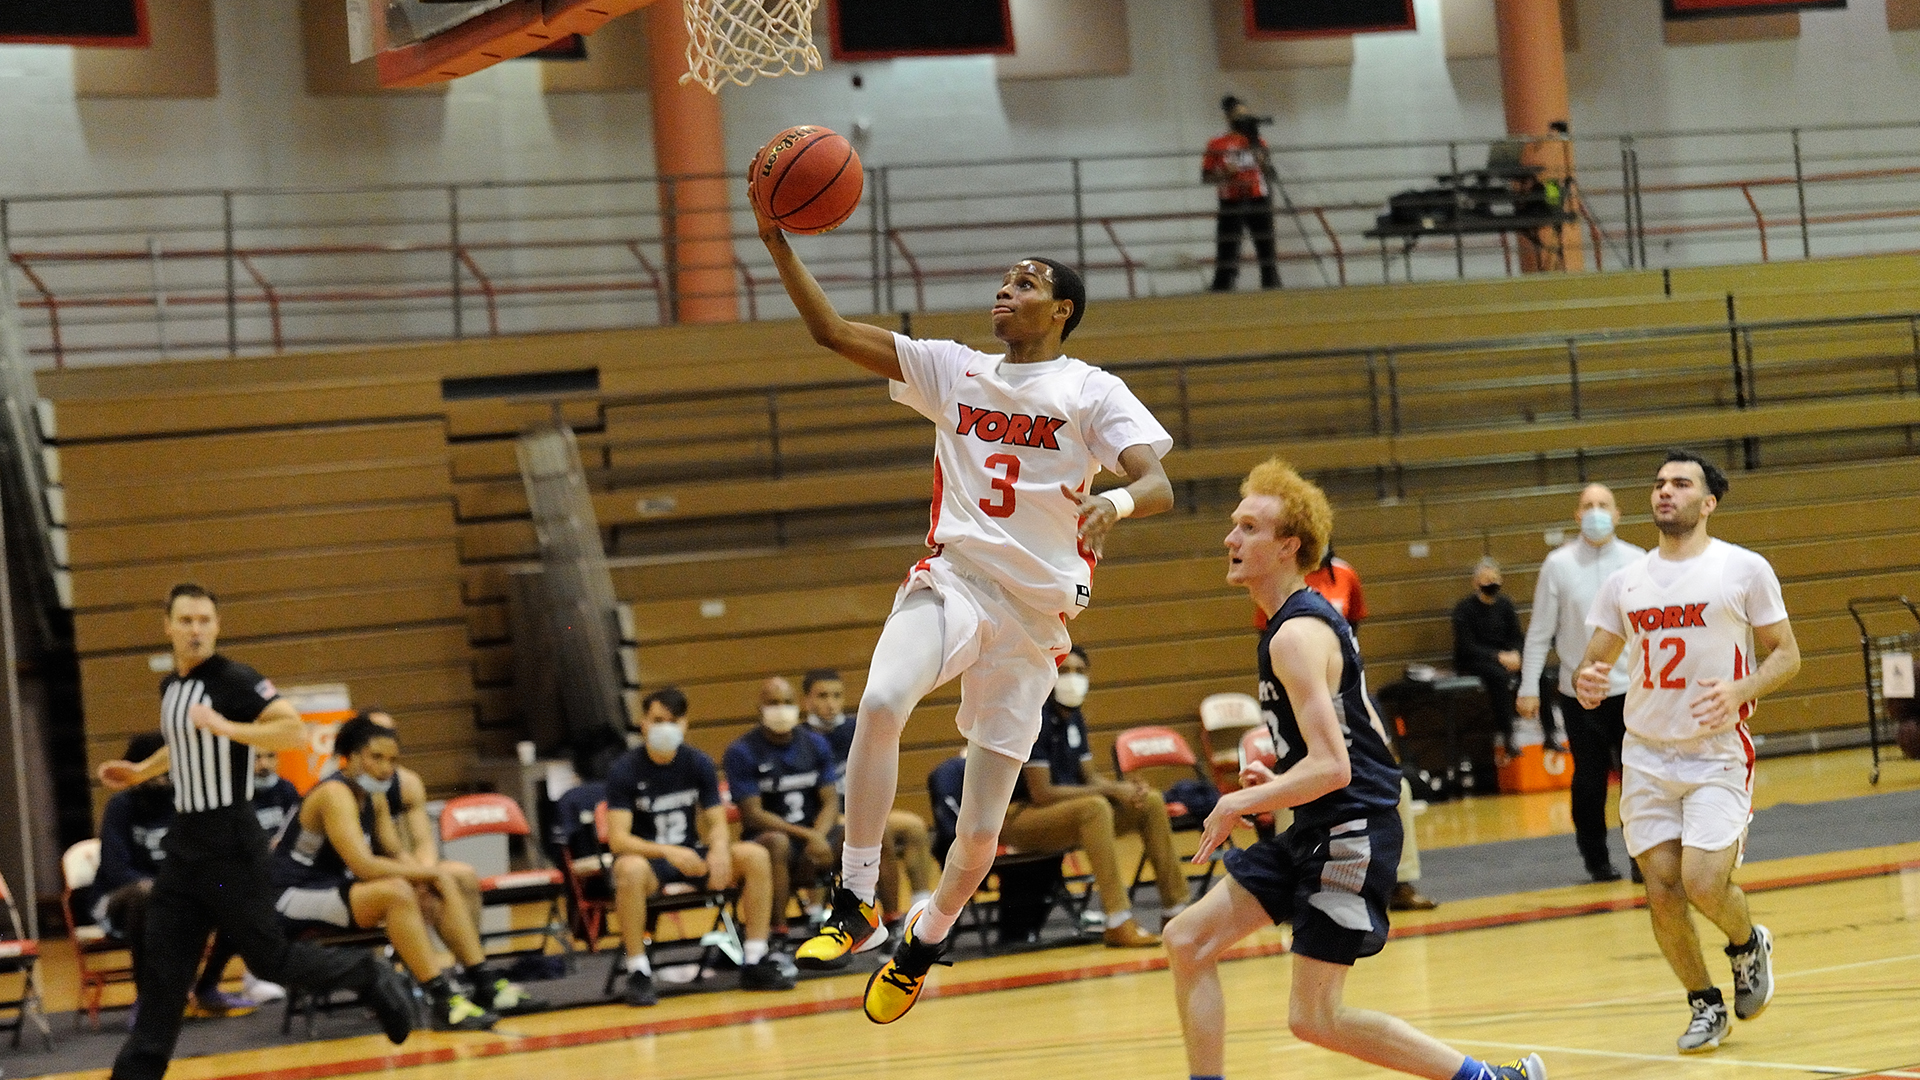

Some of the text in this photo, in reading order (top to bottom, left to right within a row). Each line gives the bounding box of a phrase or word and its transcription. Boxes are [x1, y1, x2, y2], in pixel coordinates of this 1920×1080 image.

[956, 402, 1067, 451] YORK
[979, 453, 1021, 518] 3
[1627, 602, 1709, 634] YORK
[1642, 637, 1686, 689] 12
